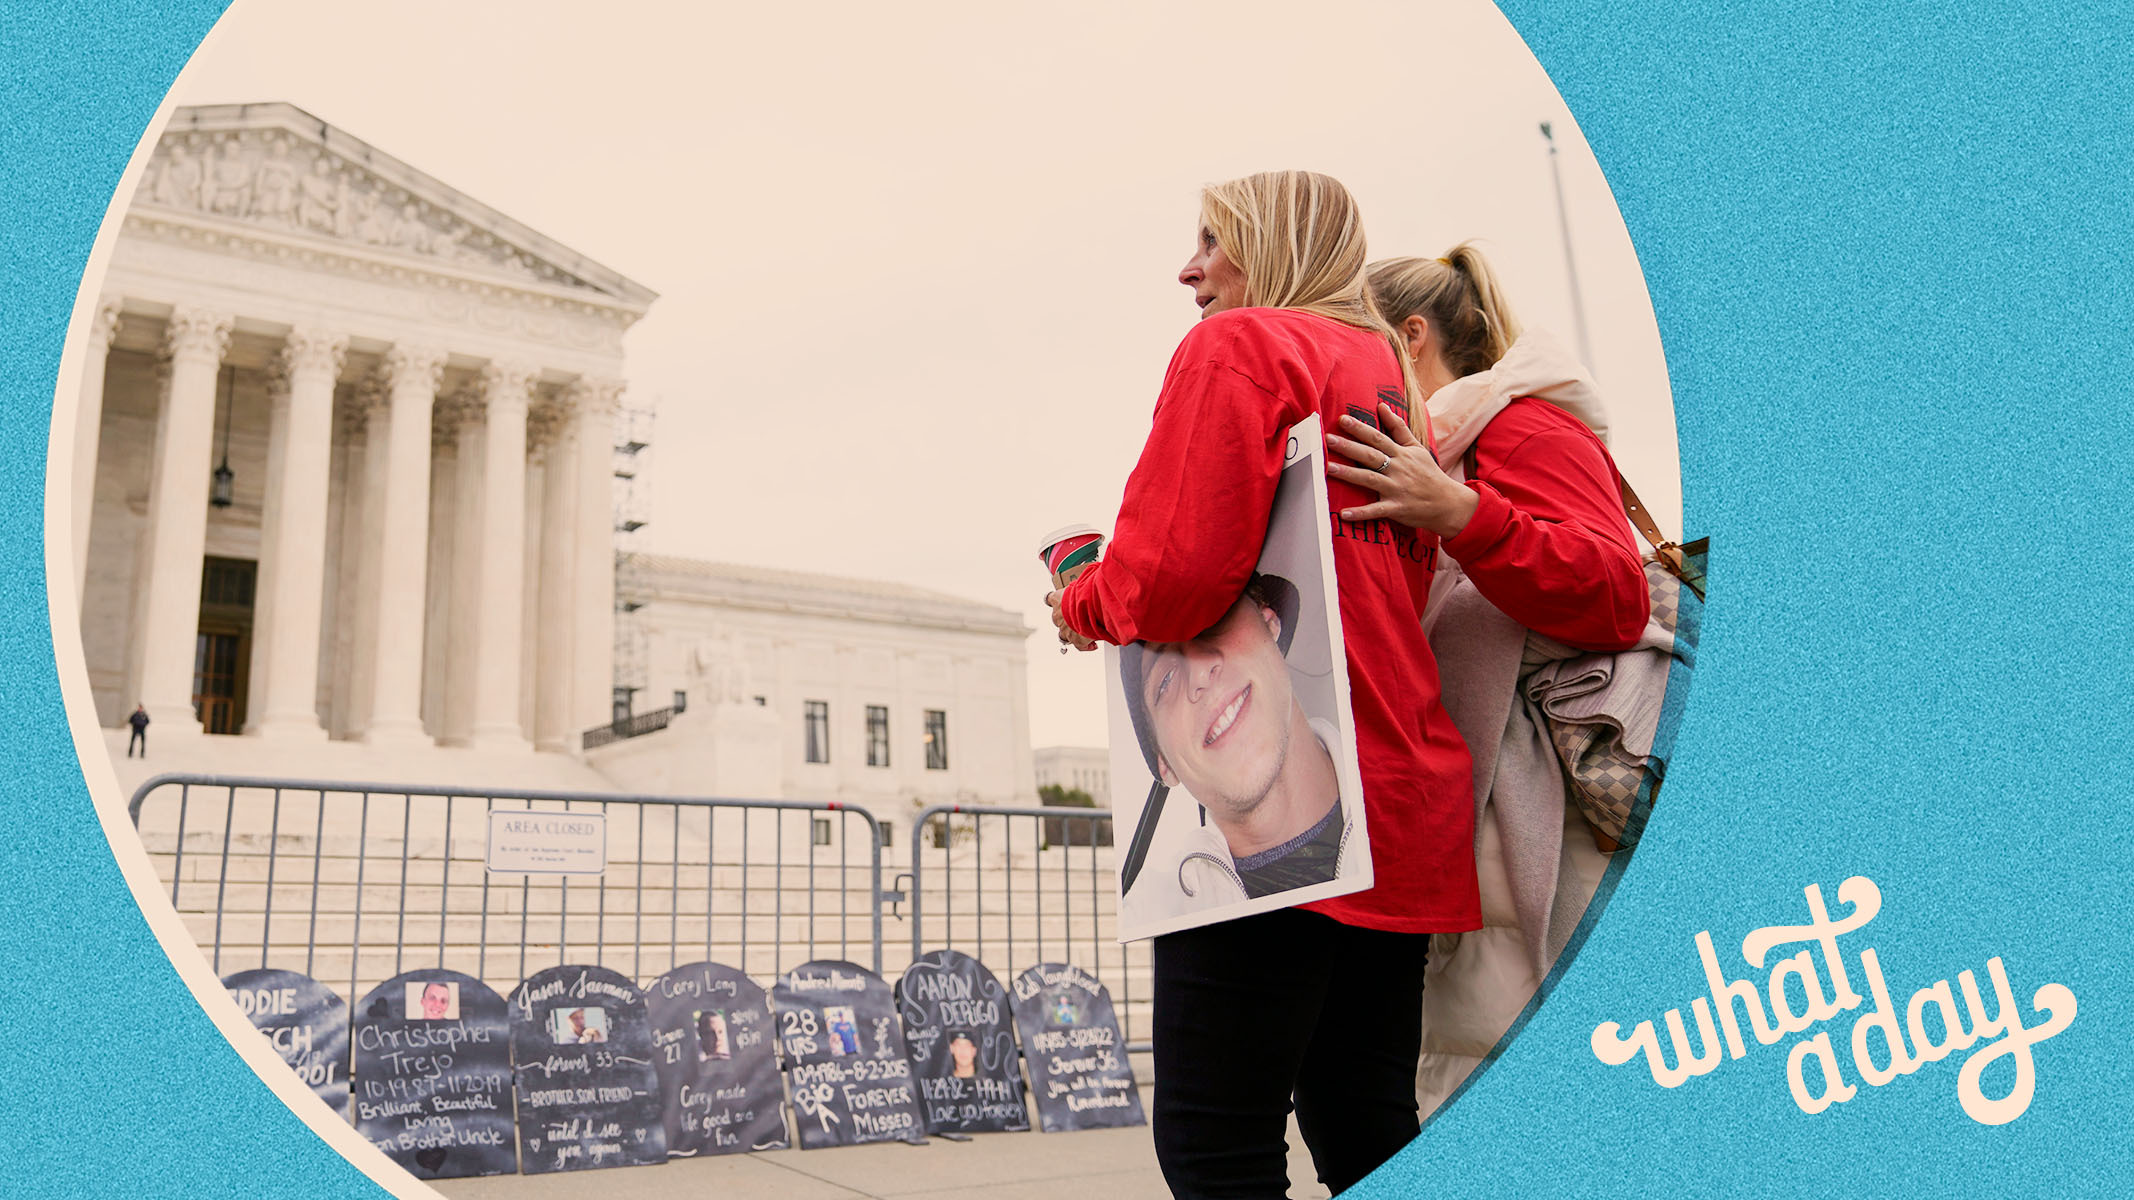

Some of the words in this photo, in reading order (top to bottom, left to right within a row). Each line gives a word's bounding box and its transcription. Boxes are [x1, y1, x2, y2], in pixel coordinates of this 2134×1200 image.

[504, 820, 541, 834] AREA
[545, 822, 595, 837] CLOSED
[704, 970, 737, 997] Long
[917, 972, 973, 1002] AARON
[517, 981, 566, 1021] Jason
[359, 1020, 492, 1053] Christopher
[783, 1009, 819, 1037] 28
[380, 1051, 453, 1080] Trejo
[544, 1054, 591, 1079] forever
[596, 1050, 614, 1068] 33
[664, 1042, 681, 1064] 27
[432, 1094, 498, 1112] Beautiful
[598, 1086, 633, 1104] FRIEND
[716, 1082, 746, 1100] made
[404, 1115, 453, 1134] Loving
[703, 1107, 731, 1138] good
[457, 1126, 506, 1147] Uncle
